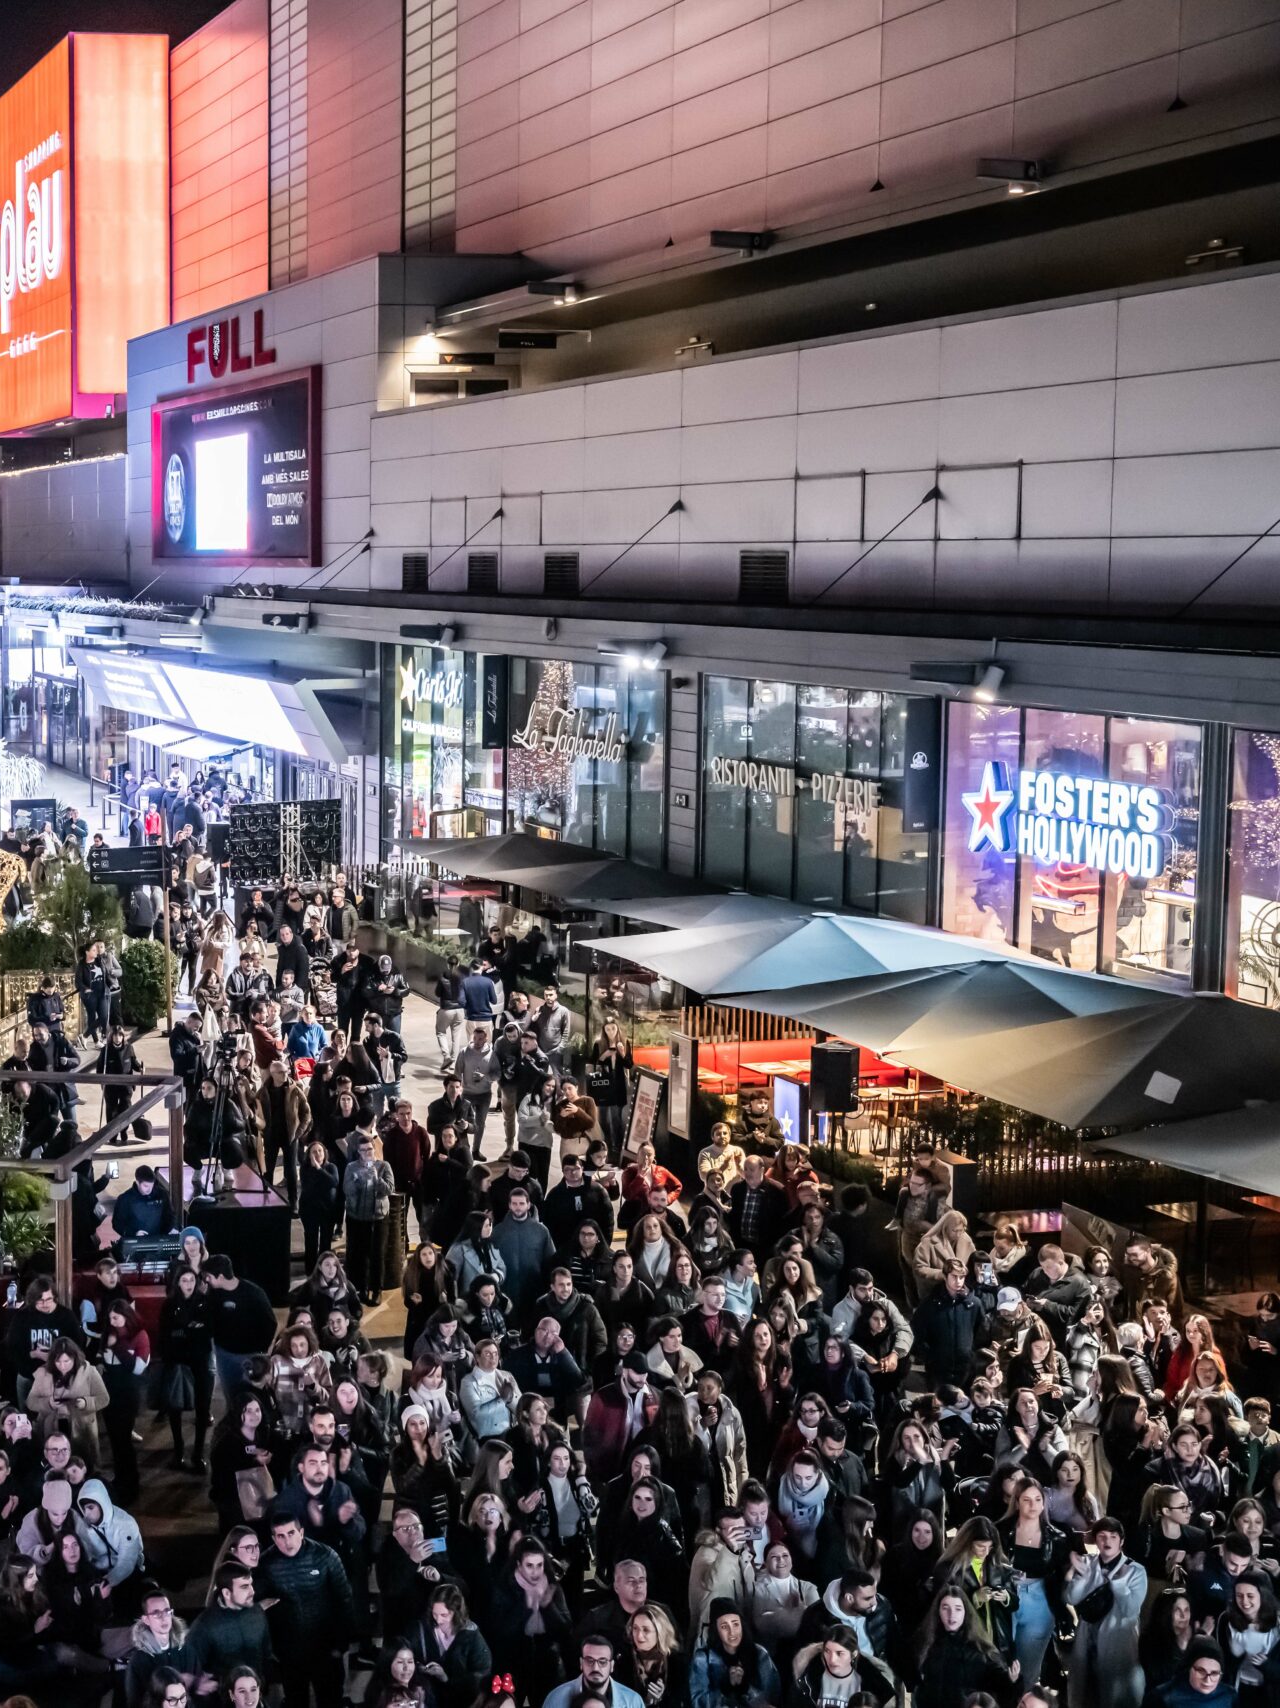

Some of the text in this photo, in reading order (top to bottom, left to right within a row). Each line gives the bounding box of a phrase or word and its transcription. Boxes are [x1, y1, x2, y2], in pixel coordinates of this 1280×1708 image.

[24, 130, 64, 173] SHOPPING
[187, 309, 276, 384] FULL
[261, 474, 274, 485] AMB
[289, 469, 310, 482] SALES
[263, 448, 307, 464] LA MULTISALA
[271, 514, 284, 526] DEL
[511, 701, 627, 765] La Tagliatella
[709, 756, 882, 811] RISTORANTI PIZZERIE
[1018, 770, 1164, 834] FOSTER'S
[1017, 820, 1164, 879] HOLLYWOOD
